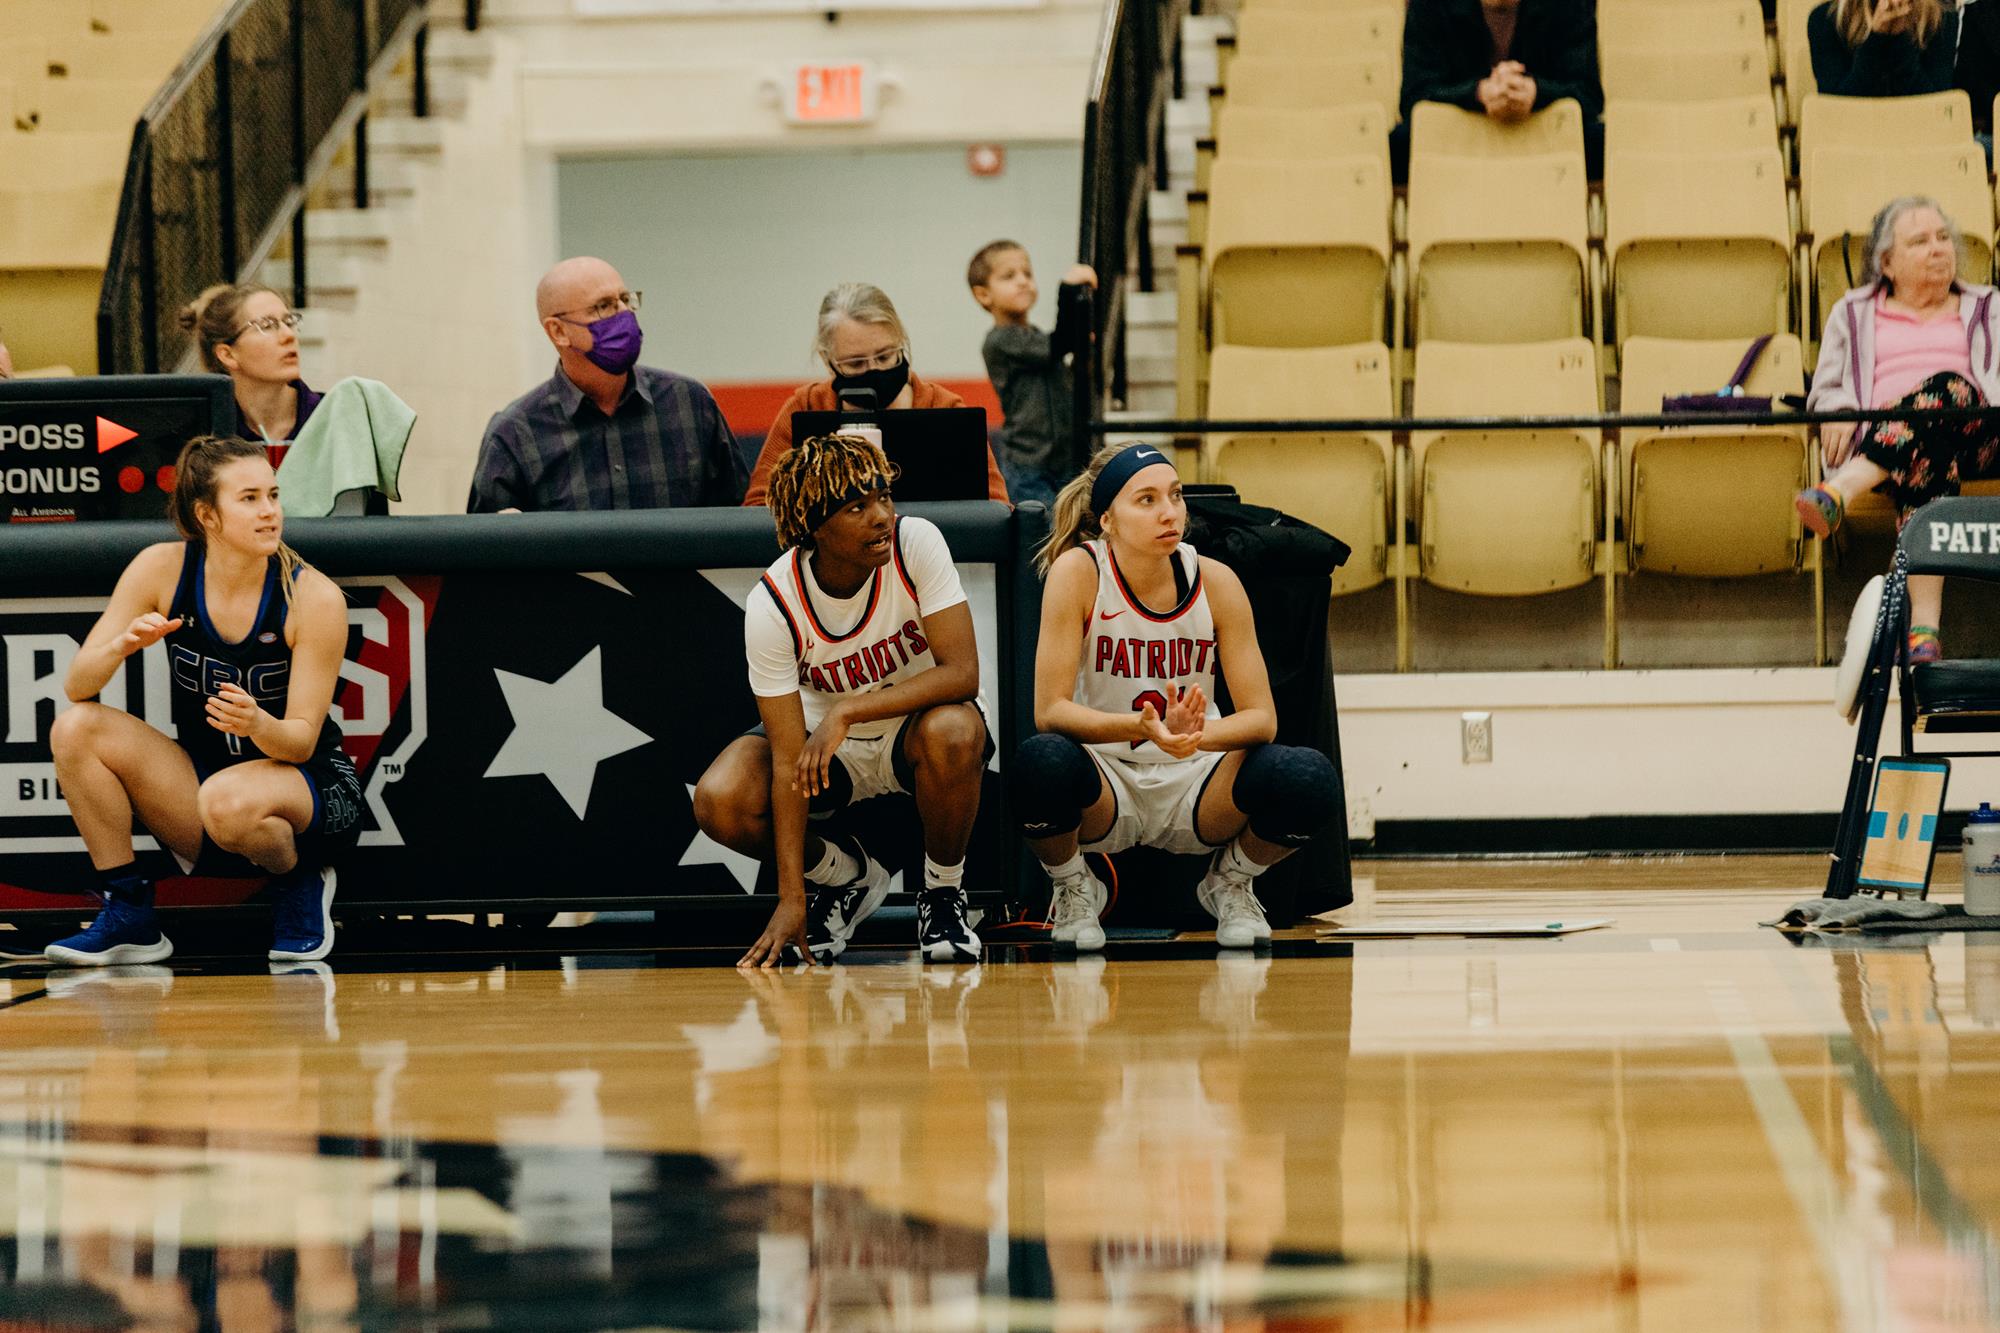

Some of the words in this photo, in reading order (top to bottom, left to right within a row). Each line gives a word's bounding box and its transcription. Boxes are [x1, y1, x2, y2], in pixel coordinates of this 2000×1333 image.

[798, 65, 863, 119] EXIT
[0, 424, 85, 451] POSS
[171, 643, 288, 701] CBC
[1095, 635, 1217, 679] PATRIOT
[383, 764, 401, 774] TM
